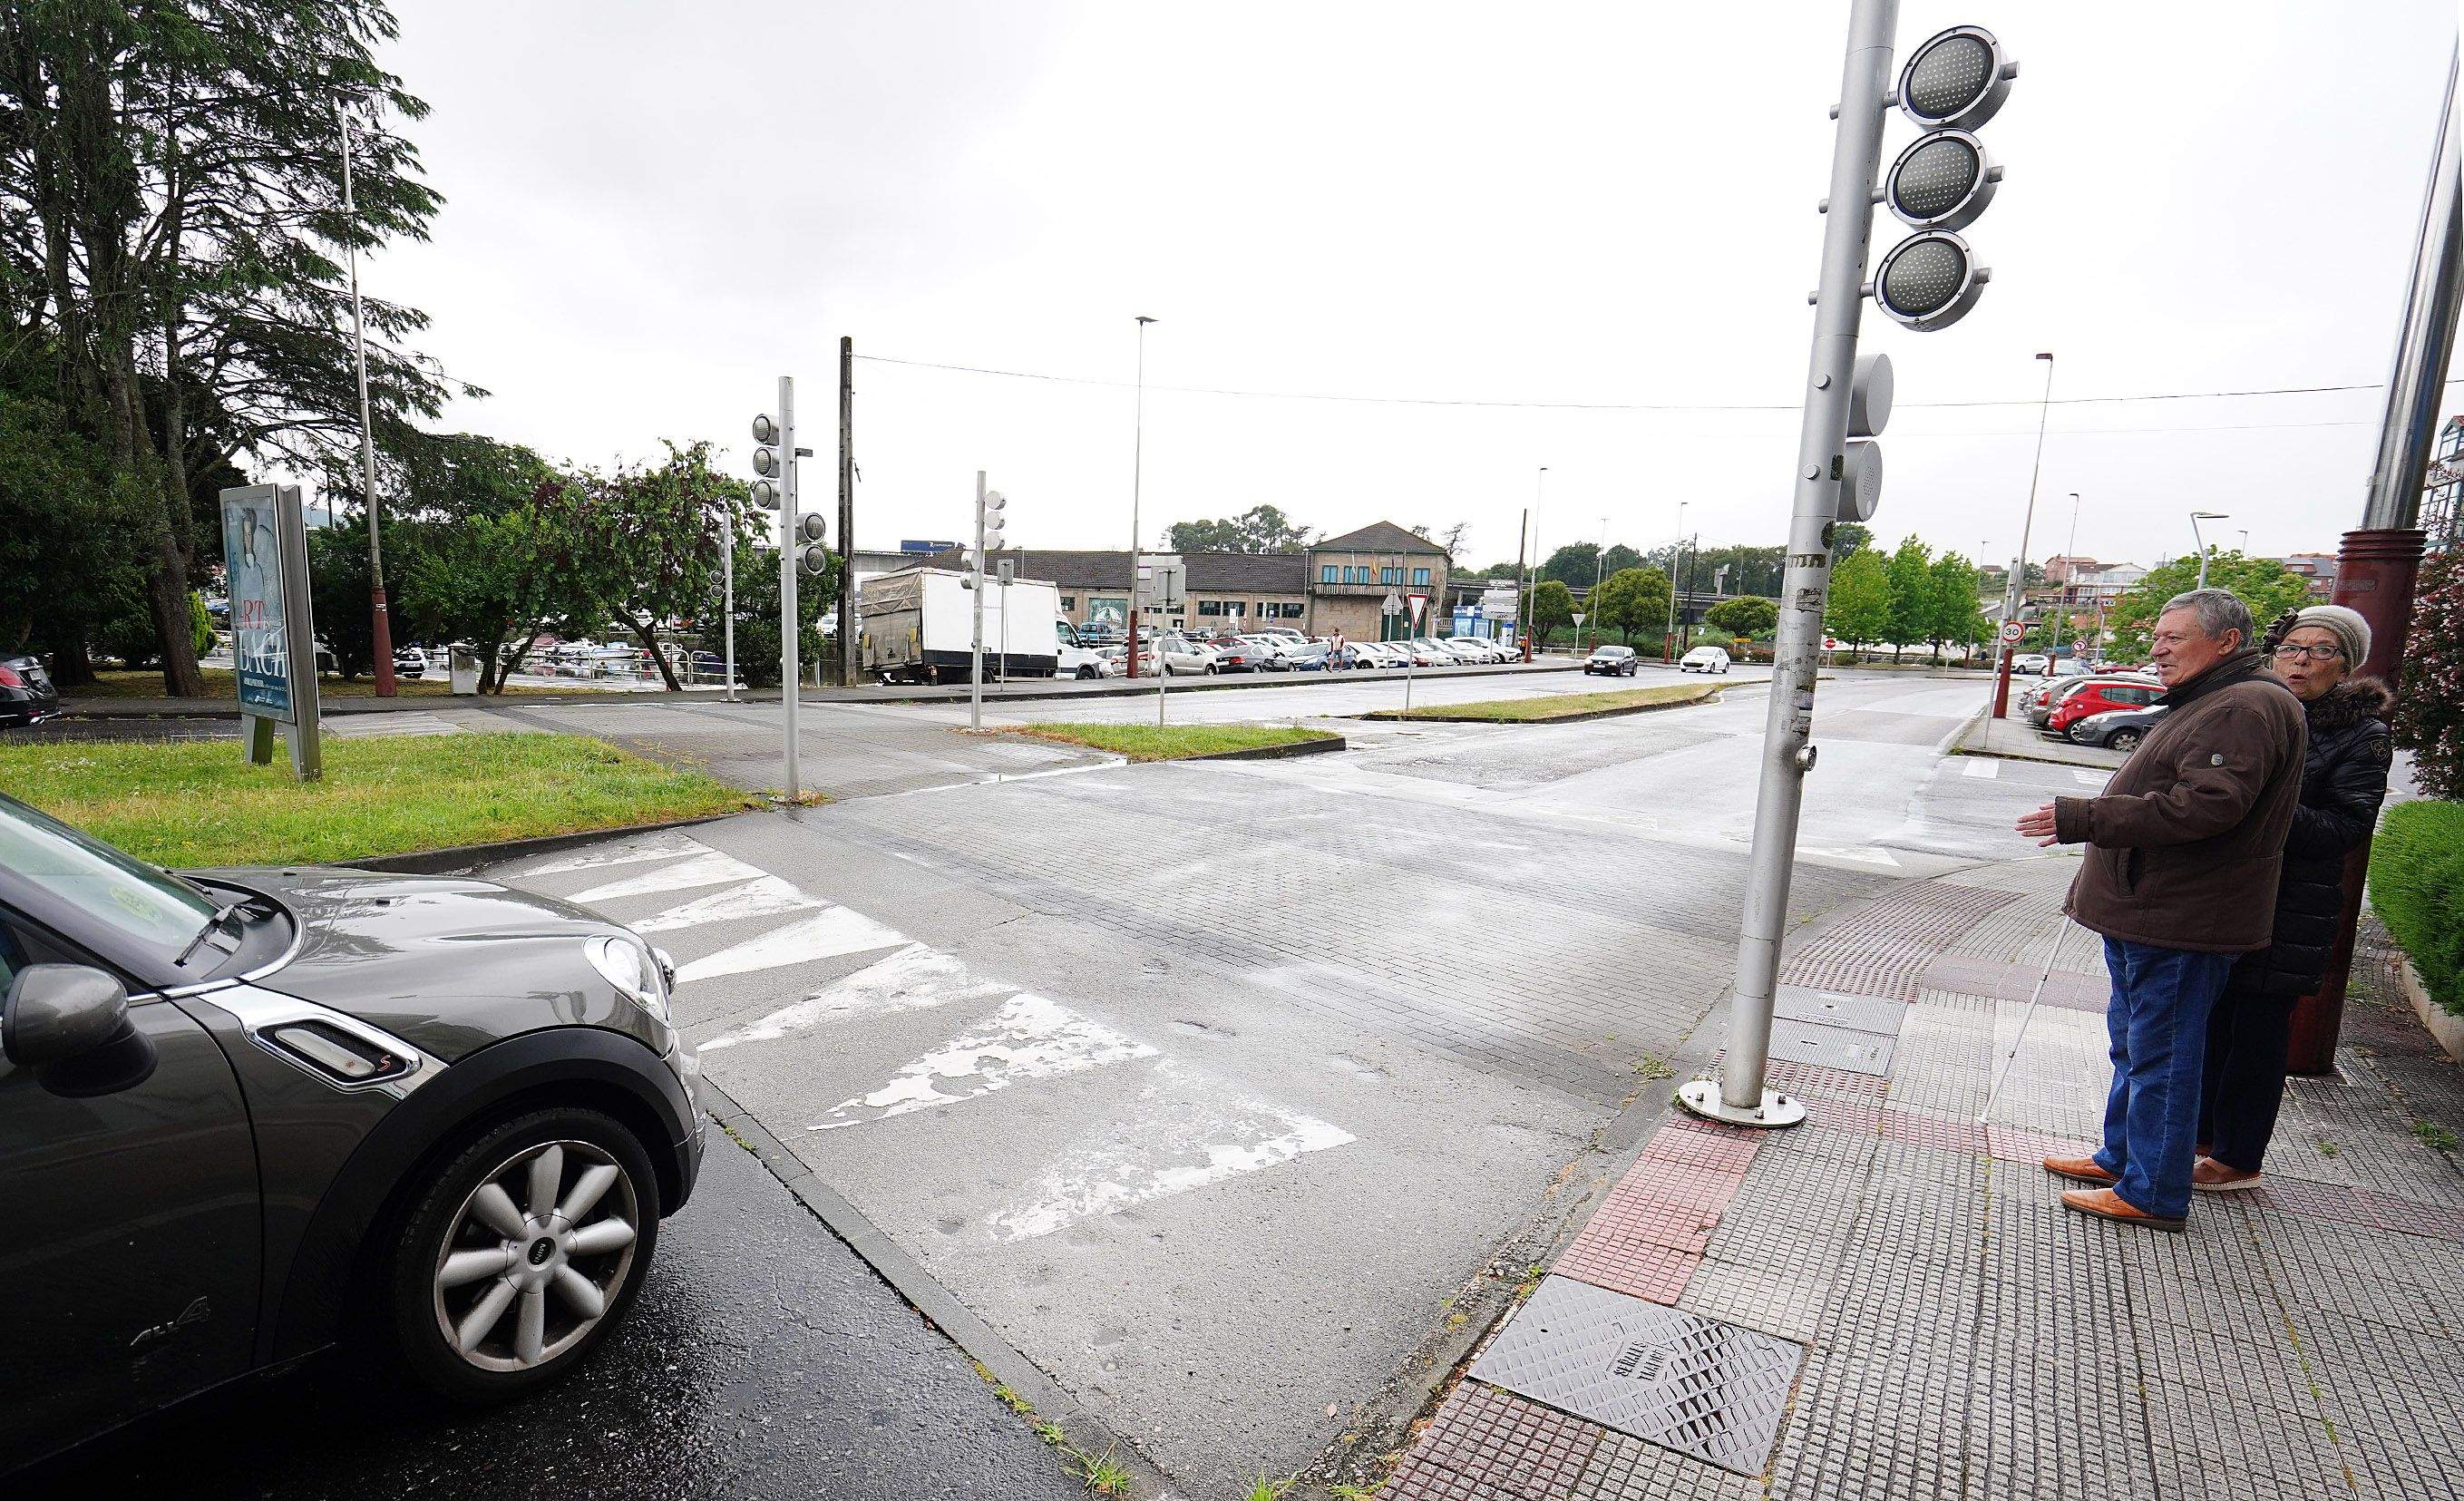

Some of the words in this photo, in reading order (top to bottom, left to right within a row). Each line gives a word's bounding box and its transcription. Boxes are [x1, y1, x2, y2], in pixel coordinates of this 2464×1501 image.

[2005, 628, 2019, 636] 30
[377, 1054, 392, 1072] S
[533, 1243, 547, 1263] MINI
